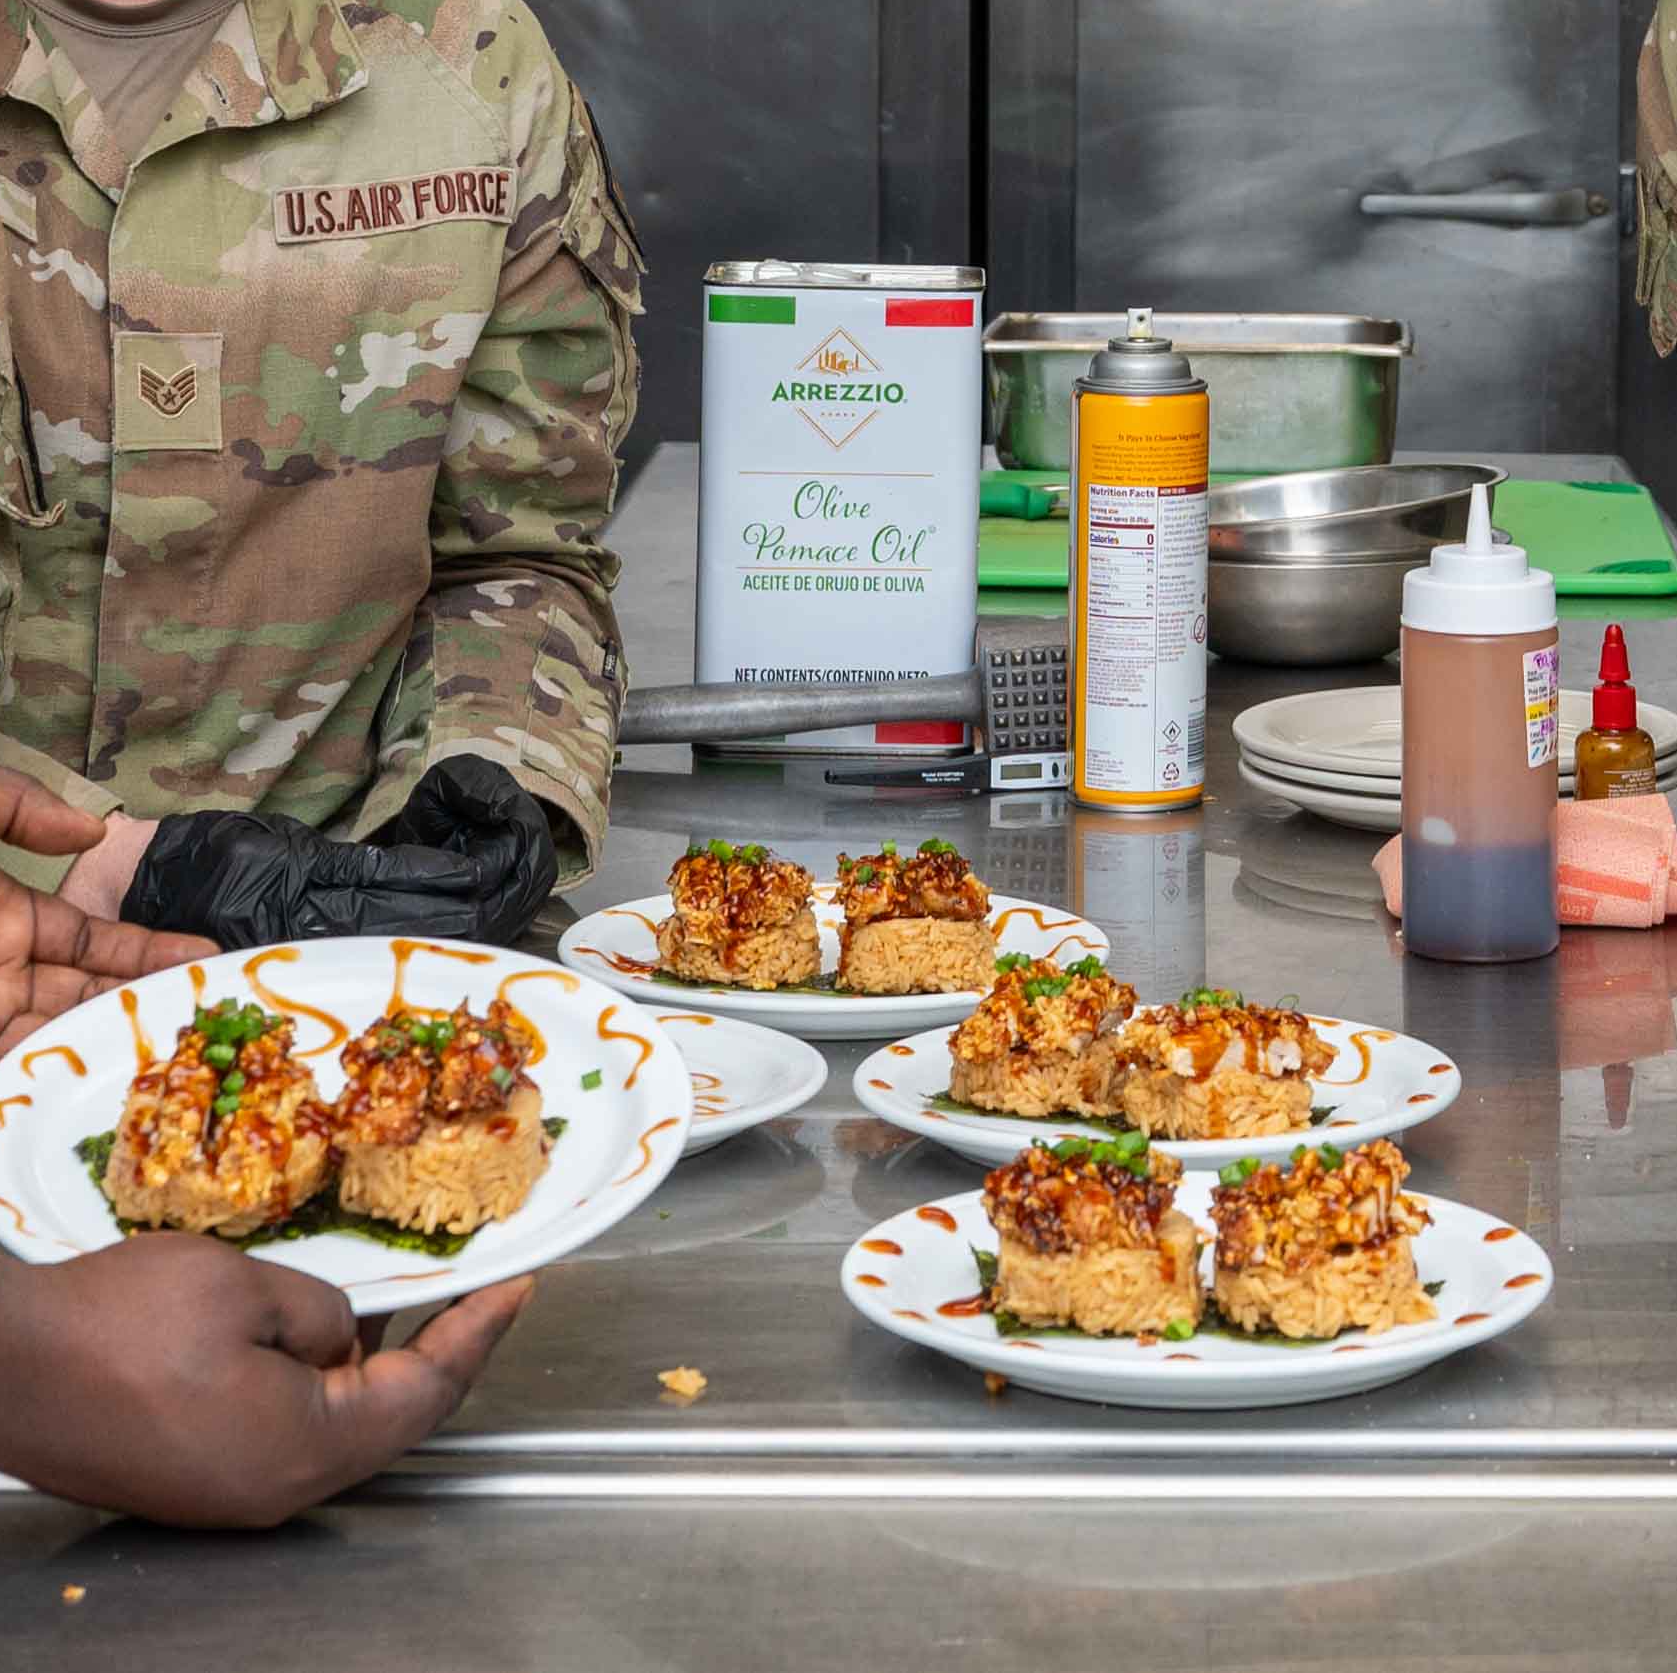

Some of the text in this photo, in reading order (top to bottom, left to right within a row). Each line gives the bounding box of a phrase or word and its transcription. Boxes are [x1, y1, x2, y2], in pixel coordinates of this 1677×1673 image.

[284, 171, 510, 236] U.S. AIR FORCE
[771, 380, 905, 404] ARREZZIO
[794, 480, 872, 520] Olive
[1090, 487, 1155, 498] Nutrition Facts
[742, 522, 926, 564] Pomace Oil
[1090, 533, 1120, 545] Calories
[1146, 533, 1155, 545] 0
[742, 574, 925, 593] ACEITE DE ORUJO DE OLIVA
[735, 667, 757, 682] NET
